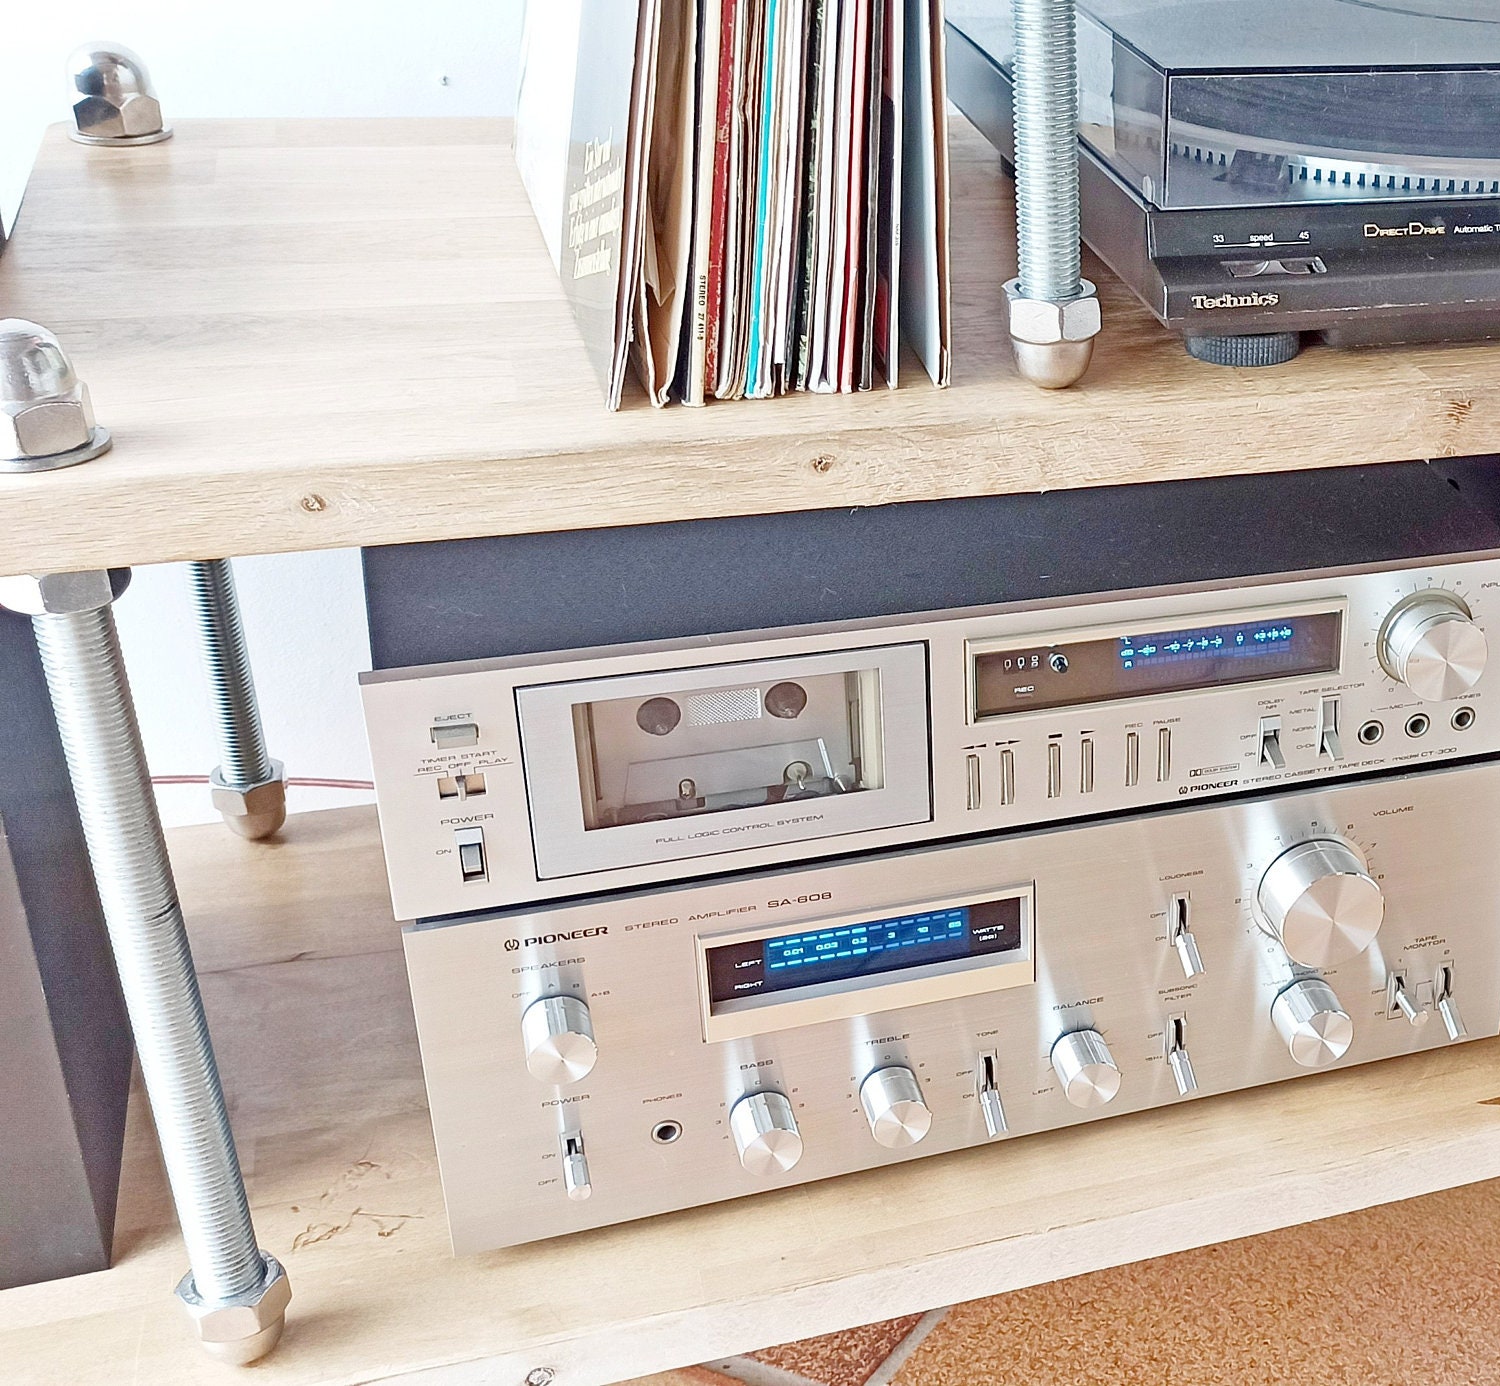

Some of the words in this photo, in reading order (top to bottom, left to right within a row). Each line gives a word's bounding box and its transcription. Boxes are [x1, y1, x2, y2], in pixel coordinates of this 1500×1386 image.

[1453, 223, 1495, 235] Automatic
[1213, 234, 1225, 243] 33
[1249, 233, 1275, 244] speed
[1299, 231, 1310, 240] 45
[1191, 291, 1280, 310] Technics
[1013, 685, 1035, 693] REC
[1299, 688, 1319, 696] TAPE
[1321, 682, 1366, 693] SELECTOR
[1258, 698, 1285, 706] DOLBY
[1289, 707, 1317, 715] METAL
[434, 712, 473, 722] EJECT
[1152, 717, 1181, 726] PAUSE
[420, 755, 457, 765] TIMER
[461, 750, 498, 760] START
[417, 764, 442, 773] REC
[447, 761, 472, 770] OFF
[478, 757, 510, 766] PLAY
[1190, 779, 1239, 793] PIONEER
[1242, 774, 1282, 785] STEREO
[1284, 765, 1335, 778] CASSETTE
[1337, 762, 1360, 770] TAPE
[1361, 757, 1386, 766] DECK
[1420, 746, 1458, 758] CT-300
[1373, 805, 1414, 817] VOLUME
[440, 813, 494, 826] POWER
[655, 836, 685, 844] FULL
[688, 829, 720, 839] LOGIC
[722, 822, 774, 834] CONTROL
[776, 814, 824, 826] SYSTEM
[1159, 870, 1204, 882] LOUDNESS
[524, 925, 609, 948] PIONEER
[624, 917, 679, 932] STEREO
[688, 905, 757, 921] AMPLIFIER
[766, 891, 832, 909] SA-608
[972, 924, 1004, 935] WATTS
[851, 936, 868, 946] 0.3
[887, 931, 896, 939] 3
[1155, 934, 1167, 942] ON
[1415, 935, 1438, 943] TAPE
[1403, 938, 1447, 951] MONITOR
[511, 957, 586, 975] SPEAKERS
[735, 959, 763, 969] LEFT
[734, 980, 764, 991] RIGHT
[1158, 984, 1197, 995] SUBSONIC
[1164, 993, 1192, 1002] FILTER
[1052, 996, 1105, 1012] BALANCE
[976, 1029, 999, 1038] TONE
[864, 1033, 911, 1047] TREBLE
[1032, 1087, 1055, 1096] LEFT
[541, 1093, 590, 1108] POWER
[642, 1092, 683, 1104] PHONES
[538, 1178, 558, 1186] OFF
